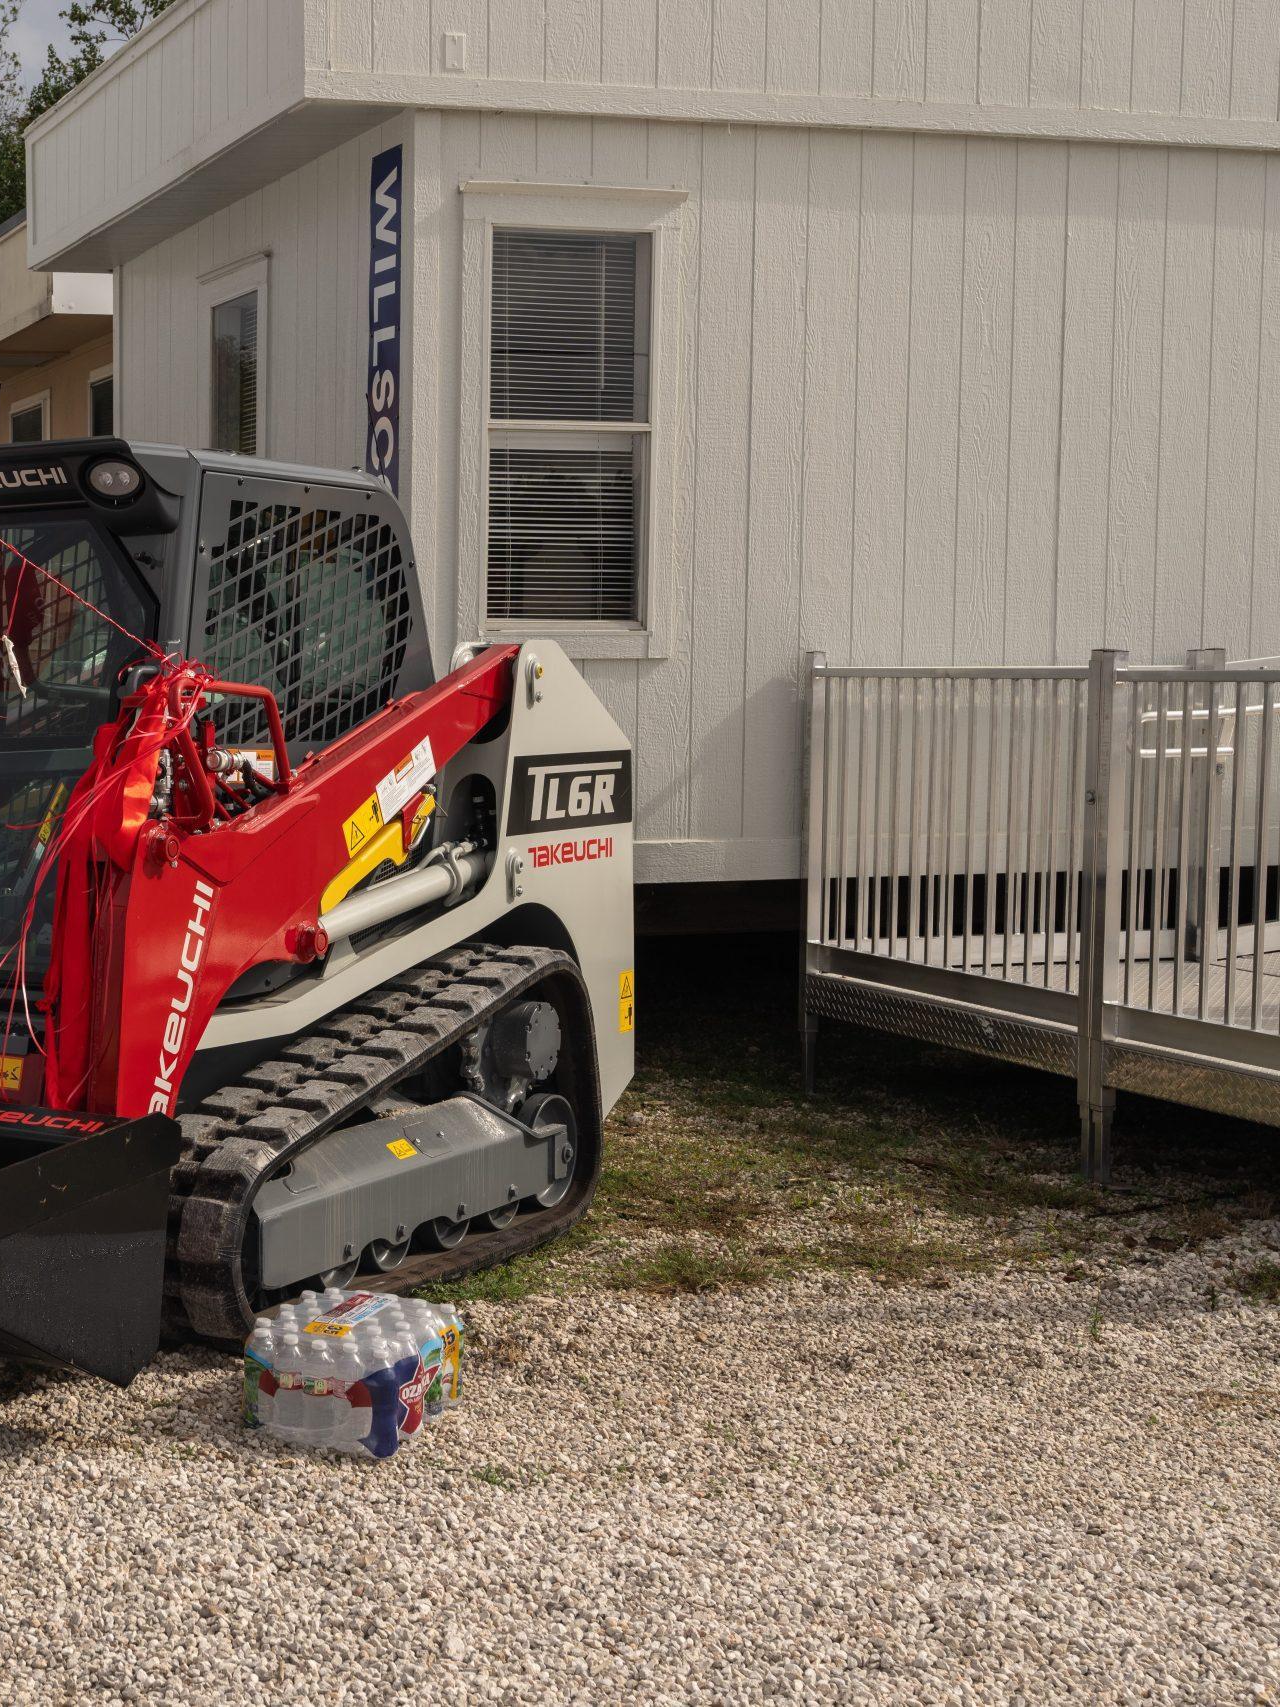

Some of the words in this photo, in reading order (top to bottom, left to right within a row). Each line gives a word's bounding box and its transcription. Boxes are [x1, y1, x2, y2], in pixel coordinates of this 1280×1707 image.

[527, 760, 623, 822] TL6R
[527, 837, 613, 868] TAKEUCHI
[148, 880, 214, 1115] AKEUCHI
